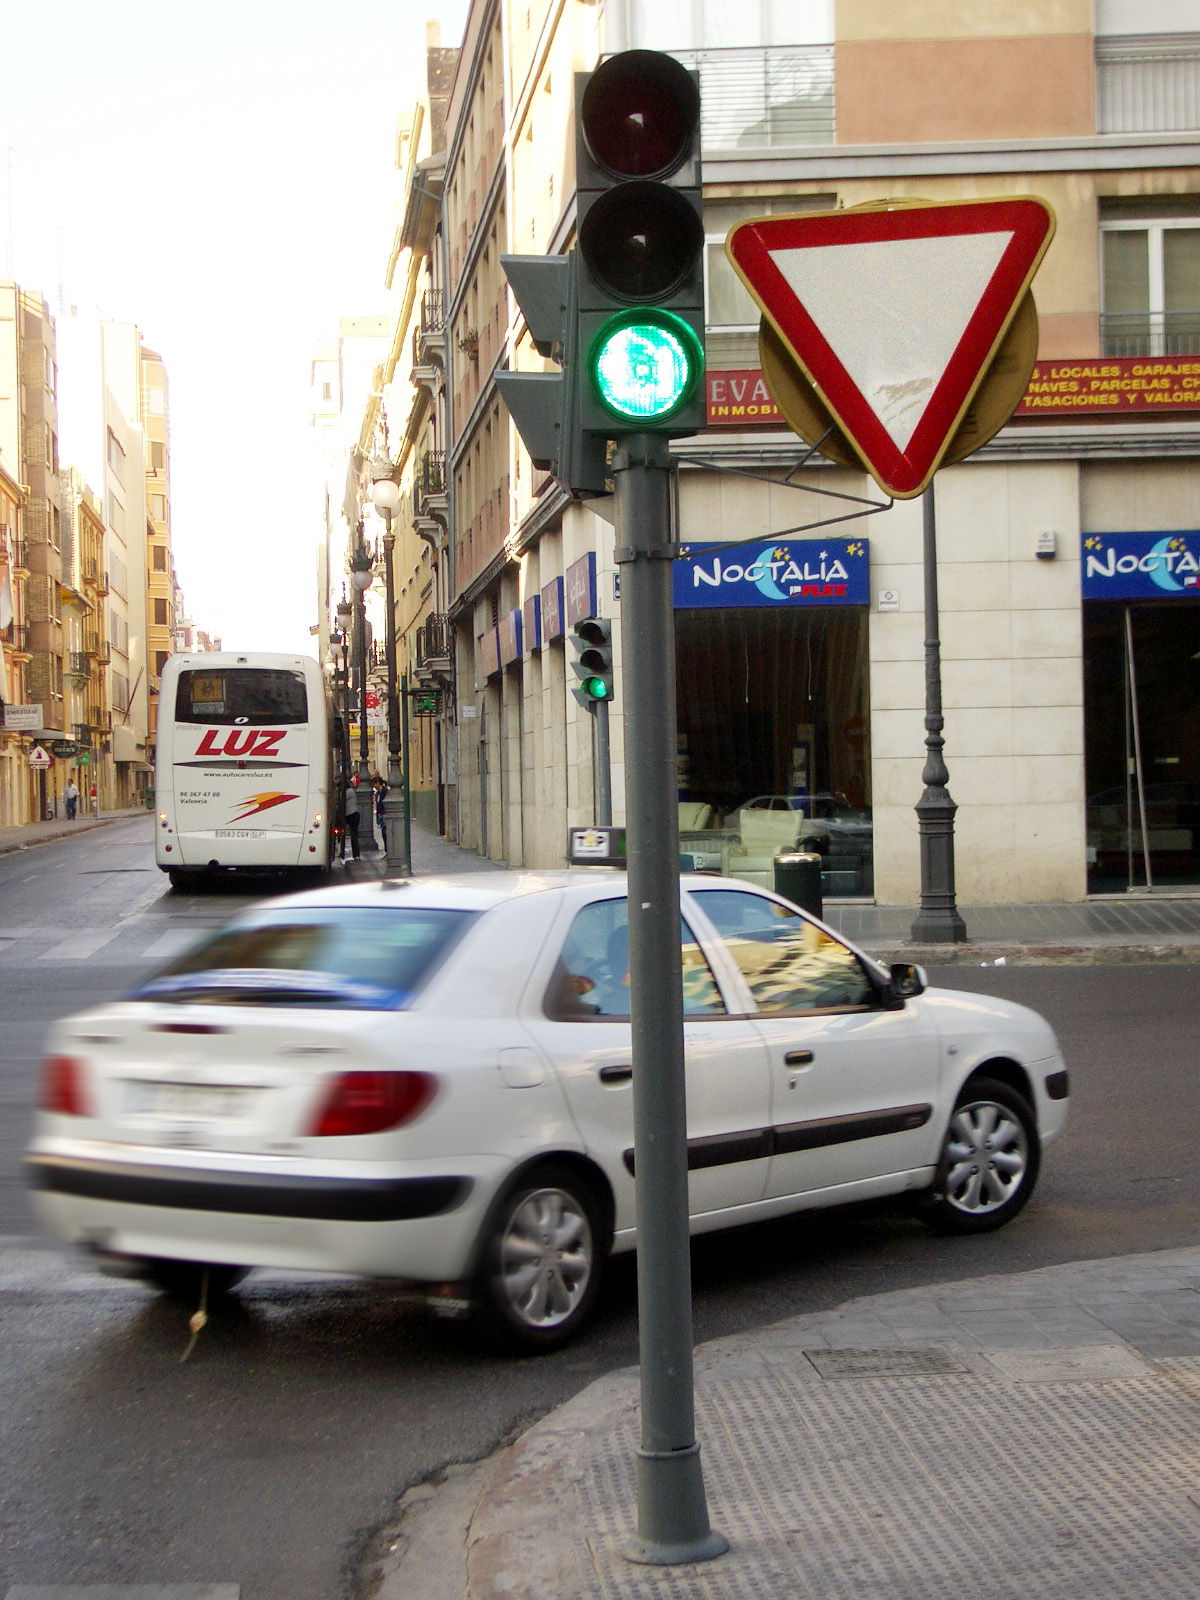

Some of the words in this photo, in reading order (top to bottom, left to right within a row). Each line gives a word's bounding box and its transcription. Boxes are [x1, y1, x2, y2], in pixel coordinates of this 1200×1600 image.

[1051, 366, 1120, 378] LOCALES
[711, 378, 770, 402] EVA
[1029, 381, 1078, 393] NAVES
[1090, 378, 1171, 391] PARCELAS
[1023, 393, 1119, 407] TASACIONES
[1126, 393, 1136, 404] Y
[195, 729, 288, 757] LUZ
